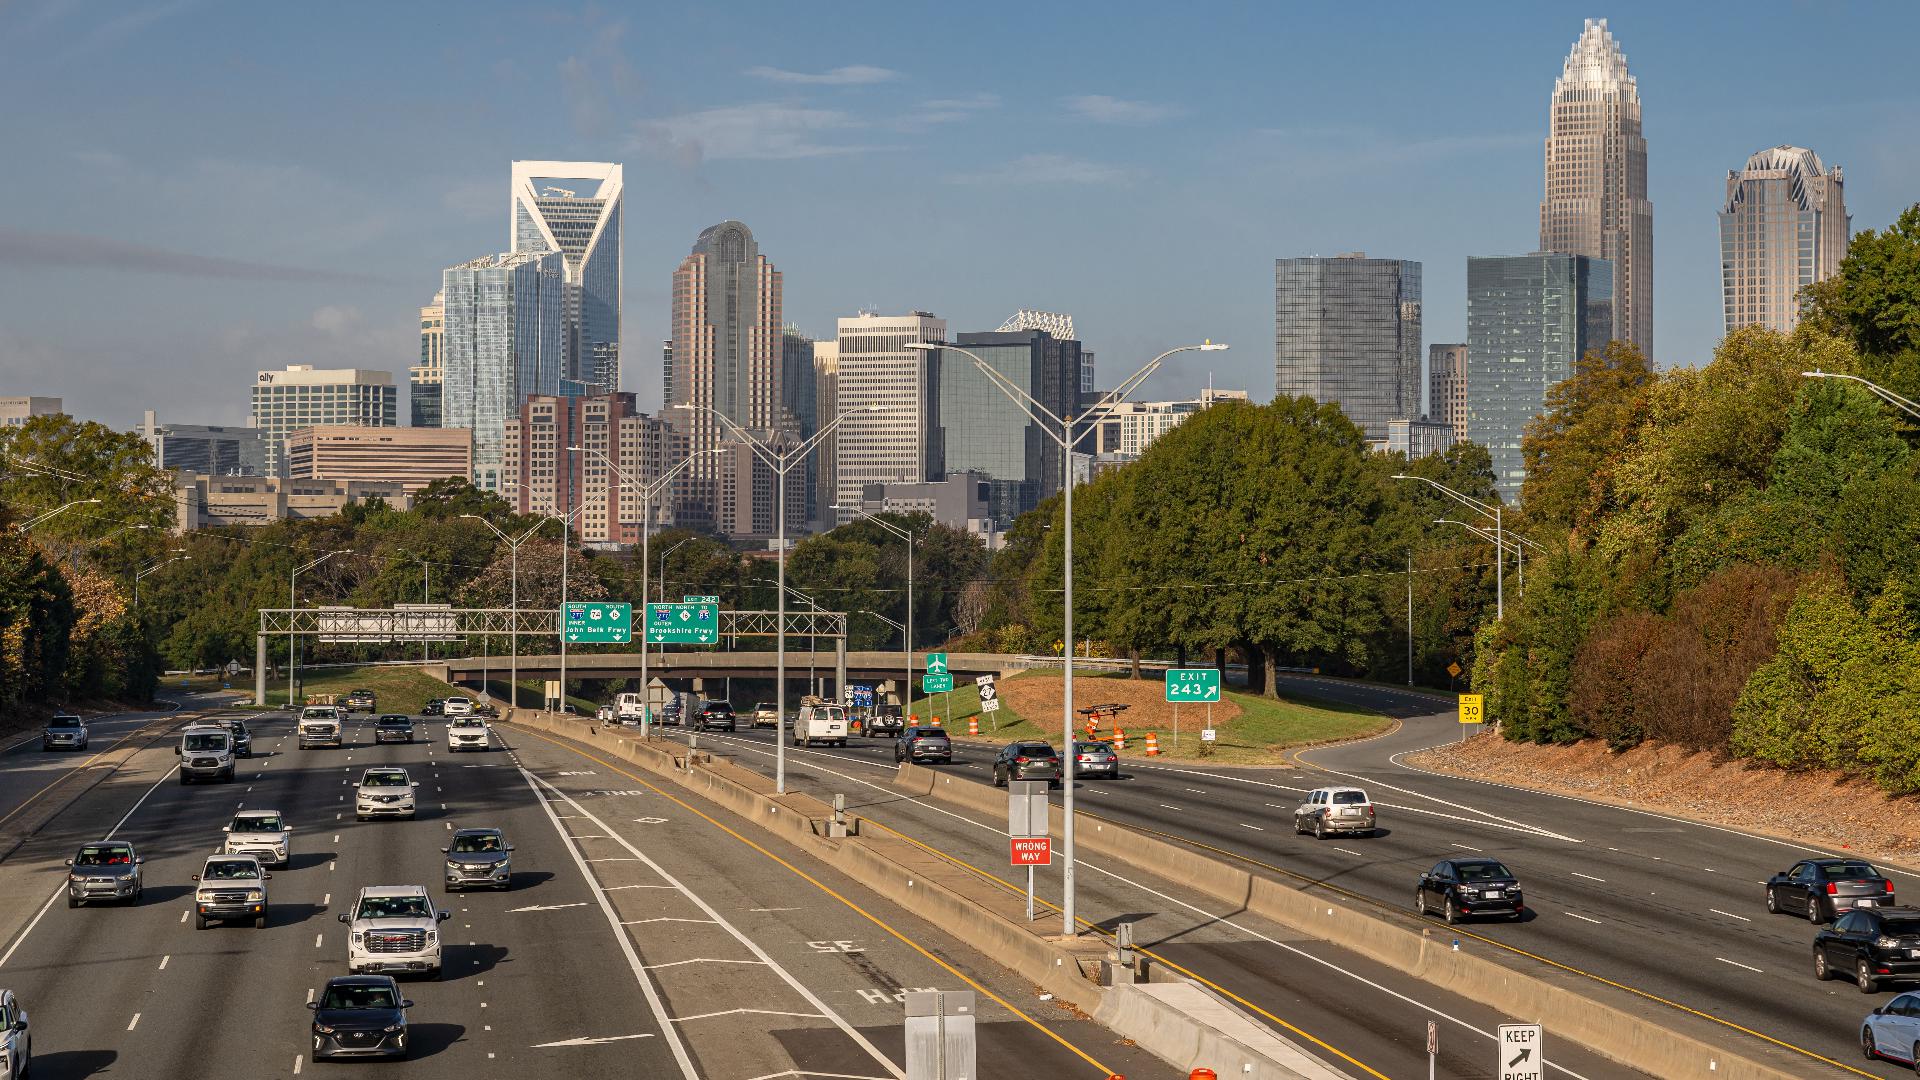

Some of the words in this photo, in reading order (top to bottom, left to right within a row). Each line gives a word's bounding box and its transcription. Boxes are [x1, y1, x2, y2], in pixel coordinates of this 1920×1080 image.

[260, 372, 274, 384] ally
[608, 626, 627, 634] Frwy
[983, 688, 992, 696] 27
[1170, 684, 1202, 694] 243
[1464, 706, 1478, 715] 30
[1016, 842, 1046, 850] WRONG
[1022, 852, 1040, 860] WAY
[806, 940, 865, 952] 35
[1506, 1030, 1535, 1042] KEEP
